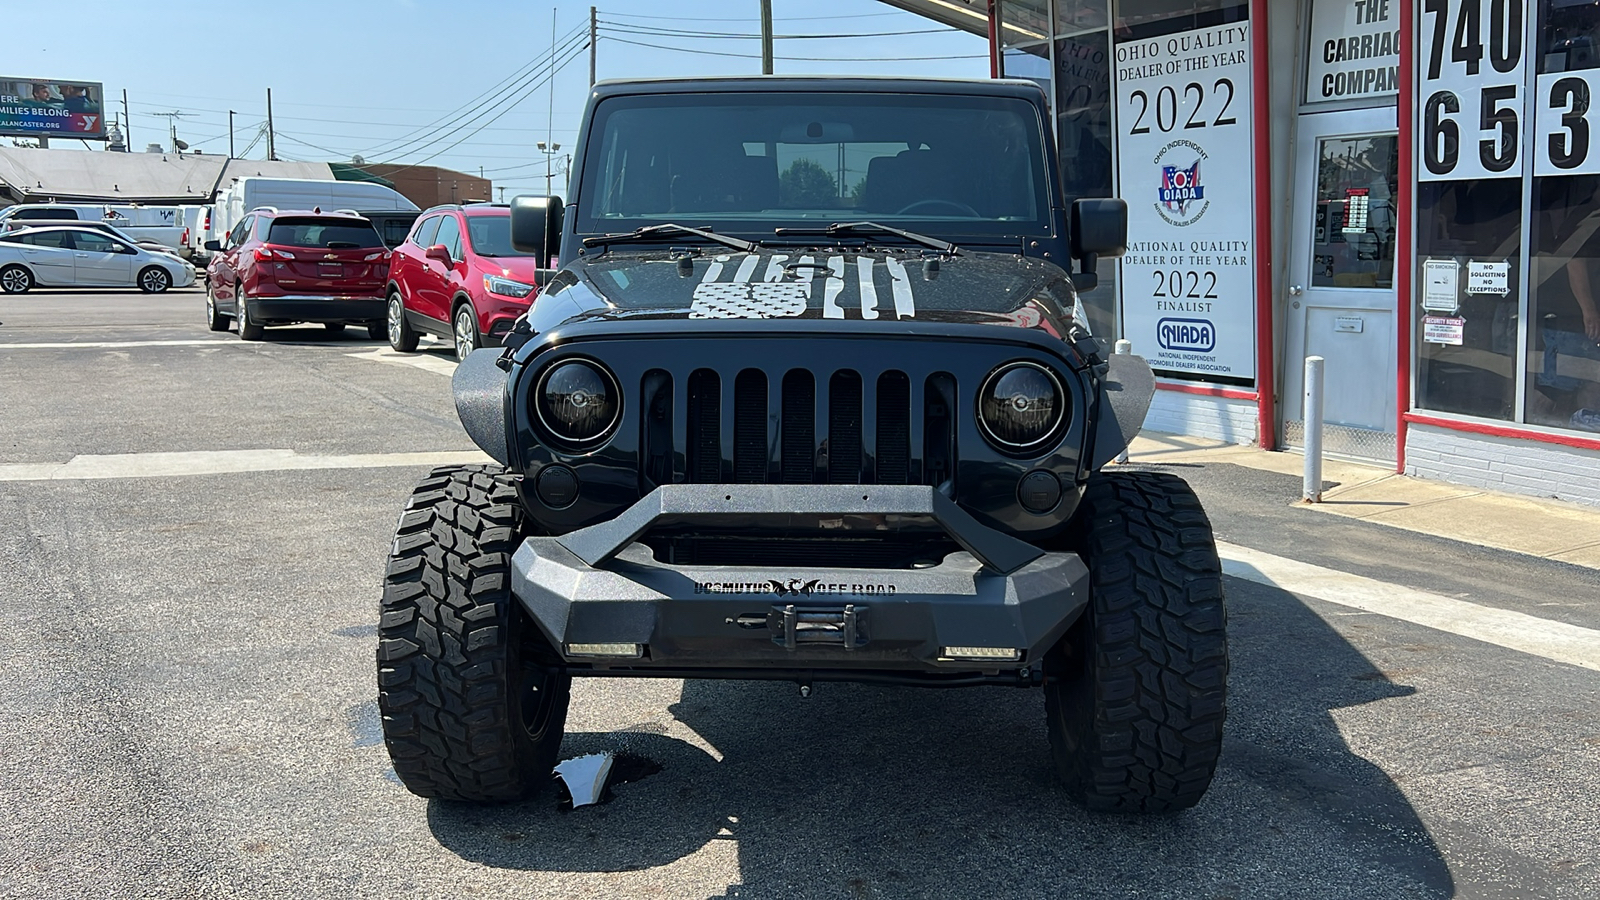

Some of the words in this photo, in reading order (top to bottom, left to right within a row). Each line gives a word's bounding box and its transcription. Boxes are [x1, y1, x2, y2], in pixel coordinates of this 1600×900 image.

[1354, 0, 1389, 25] THE
[1117, 42, 1159, 62] OHIO
[1167, 26, 1248, 56] QUALITY
[1424, 0, 1522, 80] 740
[1119, 63, 1164, 82] DEALER
[1165, 59, 1182, 75] OF
[1184, 55, 1209, 72] THE
[1211, 50, 1246, 67] YEAR
[31, 107, 73, 118] BELONG.
[1129, 77, 1237, 136] 2022
[1153, 147, 1167, 164] OHIO
[1167, 139, 1209, 161] INDEPENDENT
[1163, 188, 1197, 201] OIADA
[1126, 241, 1186, 252] NATIONAL
[1190, 241, 1249, 254] QUALITY
[1125, 255, 1166, 265] DEALER
[1170, 255, 1184, 266] OF
[1188, 255, 1212, 266] THE
[1216, 255, 1248, 266] YEAR
[1152, 270, 1218, 299] 2022
[1157, 301, 1213, 313] FINALIST
[1158, 352, 1182, 360] NATIONAL
[1183, 354, 1216, 363] INDEPENDENT
[1175, 361, 1196, 369] DEALERS
[1197, 363, 1232, 373] ASSOCIATION
[816, 583, 848, 596] OFF
[852, 583, 897, 597] ROAD
